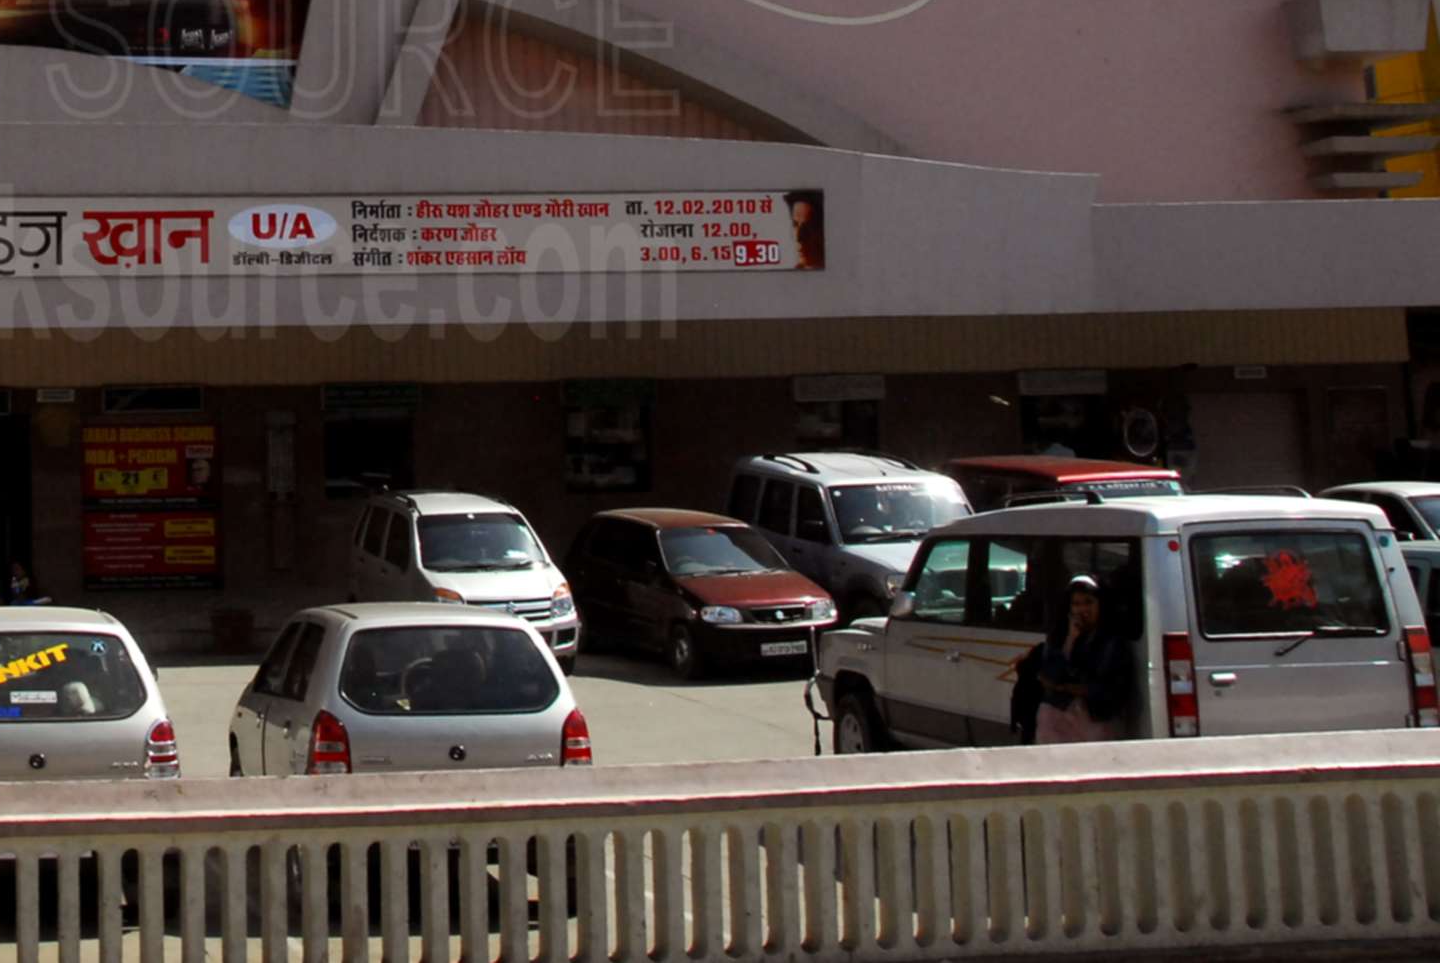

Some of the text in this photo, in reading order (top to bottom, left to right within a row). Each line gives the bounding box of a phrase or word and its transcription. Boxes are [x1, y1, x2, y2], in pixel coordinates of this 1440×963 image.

[544, 197, 574, 218] गौरी
[576, 201, 609, 218] खान
[654, 199, 757, 216] 12.02.2010
[251, 212, 315, 239] U/A
[352, 245, 392, 267] संगीत
[734, 243, 780, 265] 9.30
